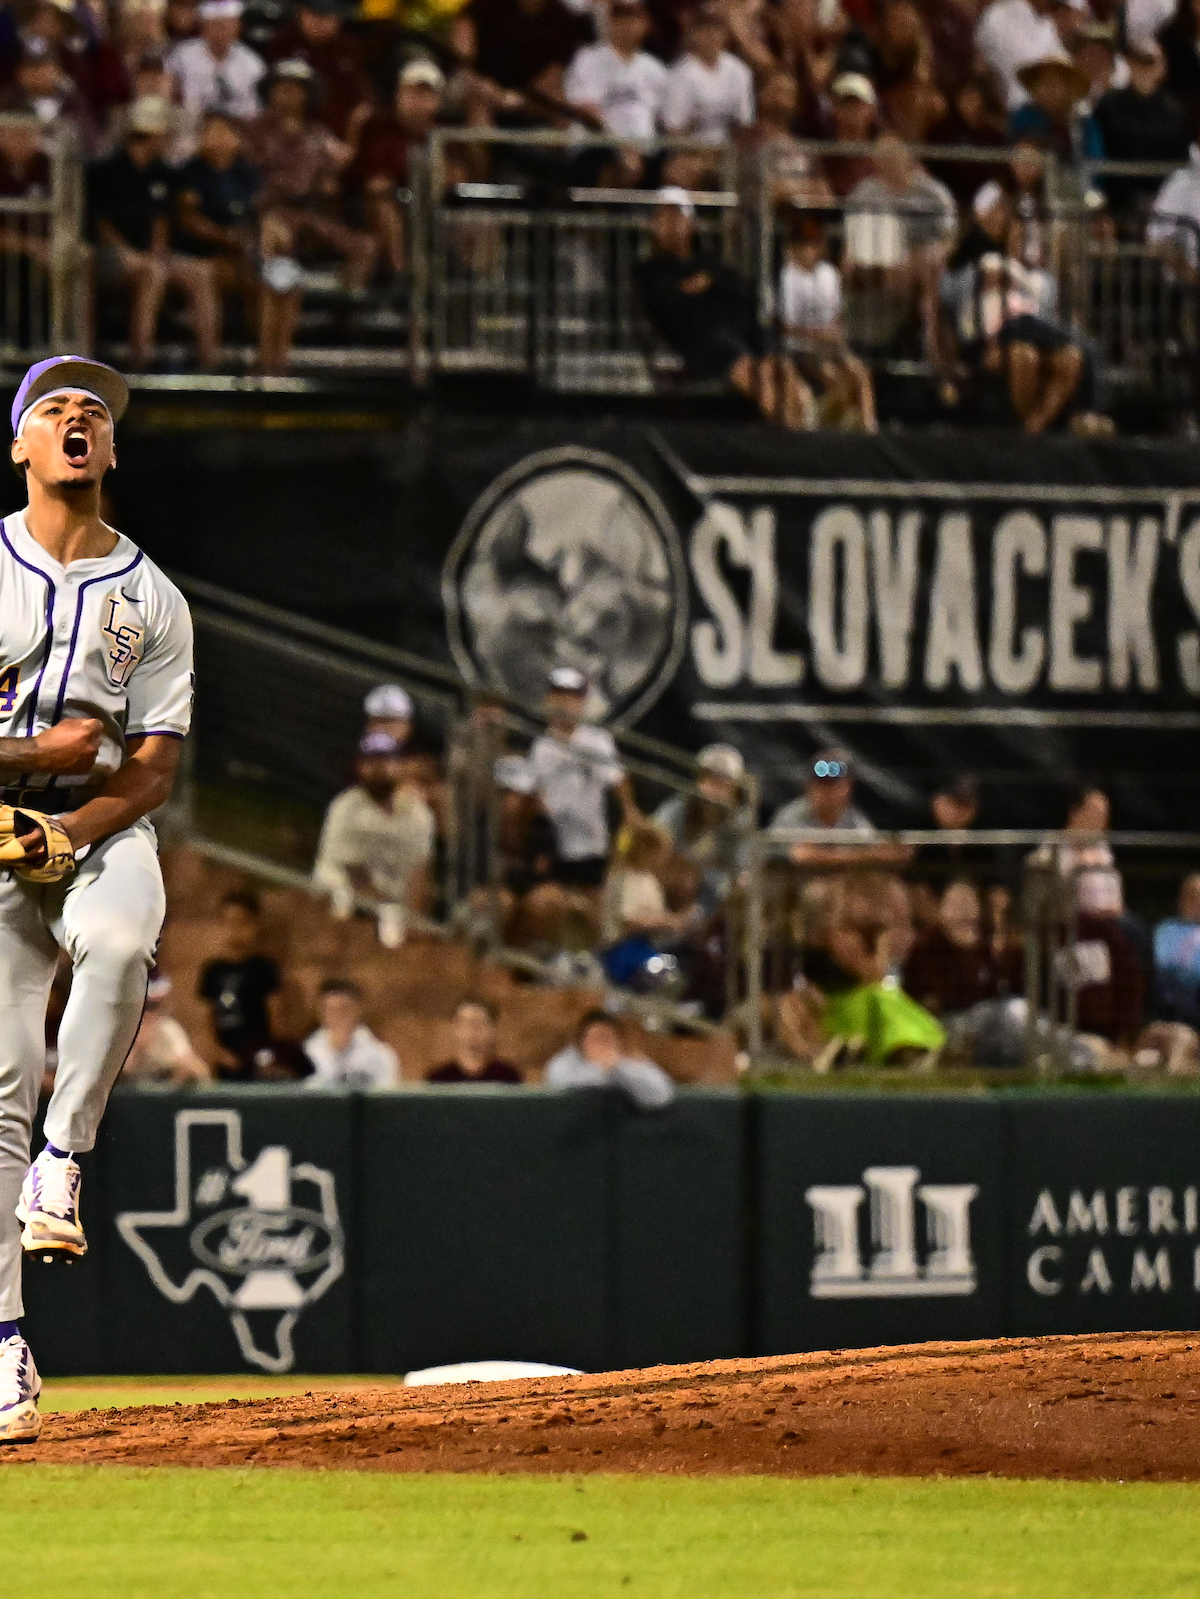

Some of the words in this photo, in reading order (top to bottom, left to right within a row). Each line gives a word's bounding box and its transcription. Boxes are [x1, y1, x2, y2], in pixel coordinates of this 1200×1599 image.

[102, 597, 143, 687] LSU
[1029, 1185, 1198, 1237] AMERI
[1027, 1245, 1200, 1296] CAM
